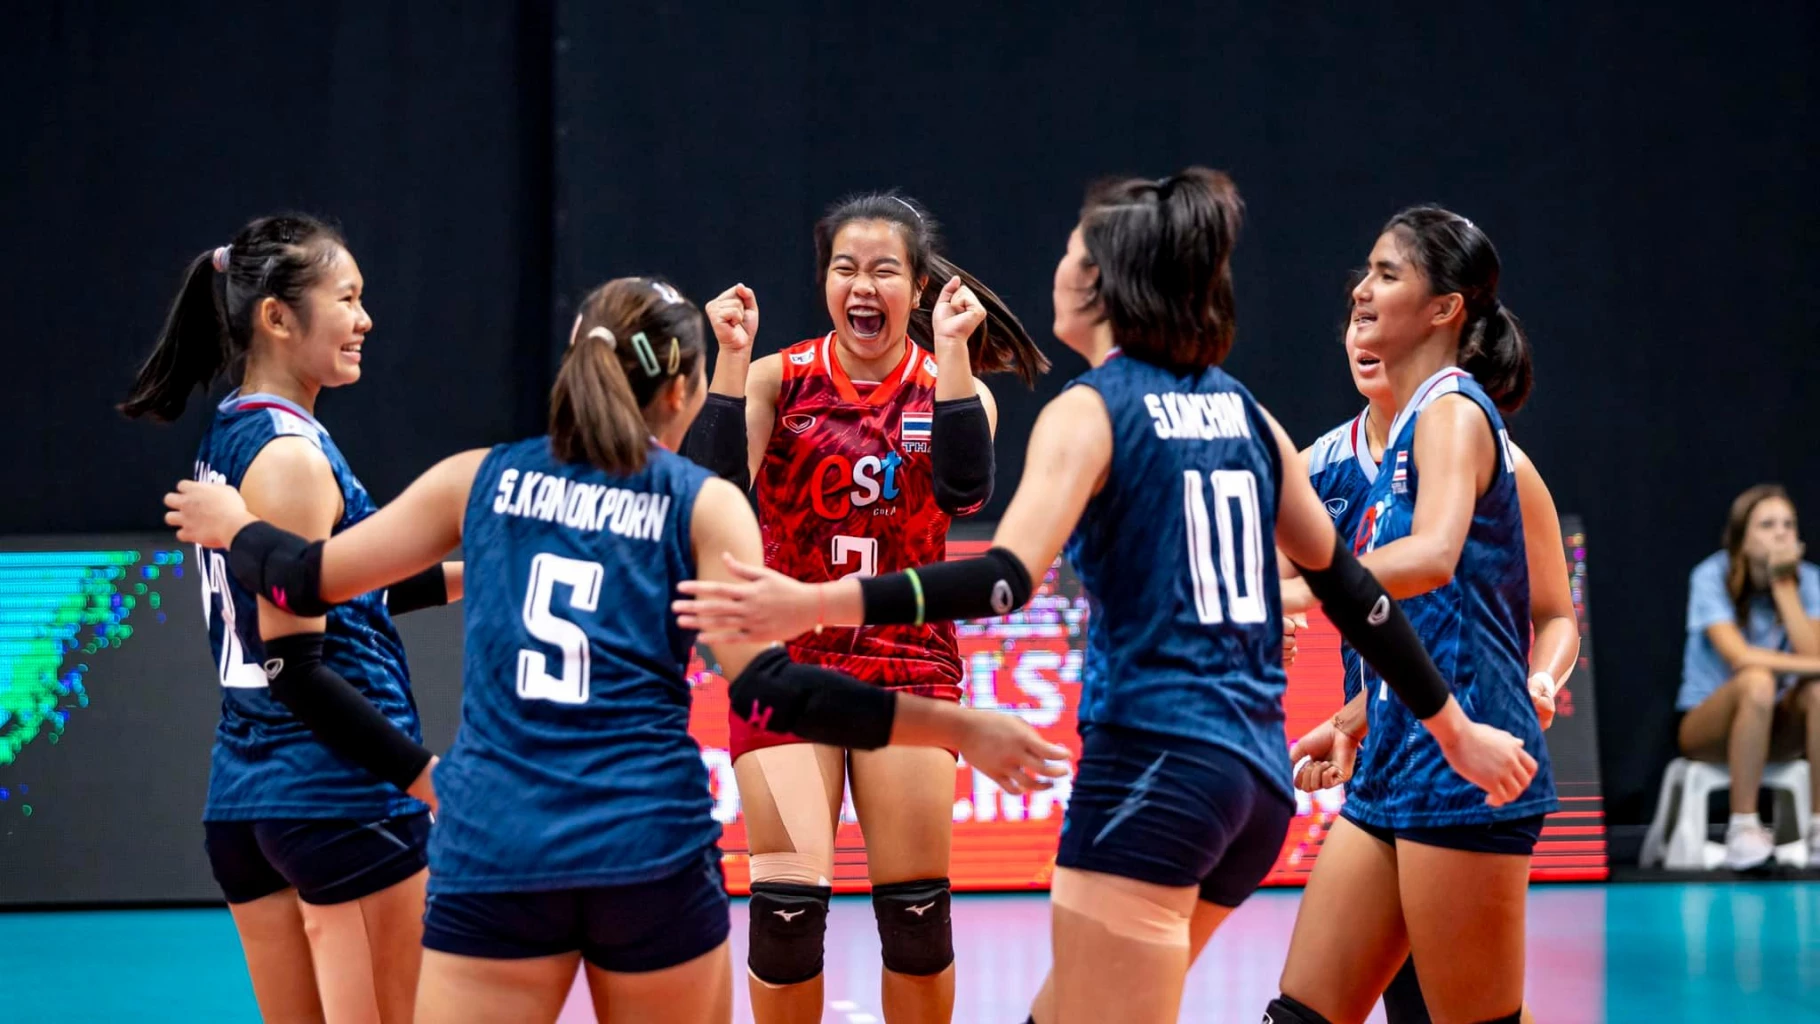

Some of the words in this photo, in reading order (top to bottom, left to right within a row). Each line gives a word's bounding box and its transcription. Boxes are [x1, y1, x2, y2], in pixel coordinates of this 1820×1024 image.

[494, 468, 670, 542] S.KANOKPORN
[812, 452, 902, 520] est
[1183, 470, 1267, 624] 10
[516, 553, 604, 705] 5
